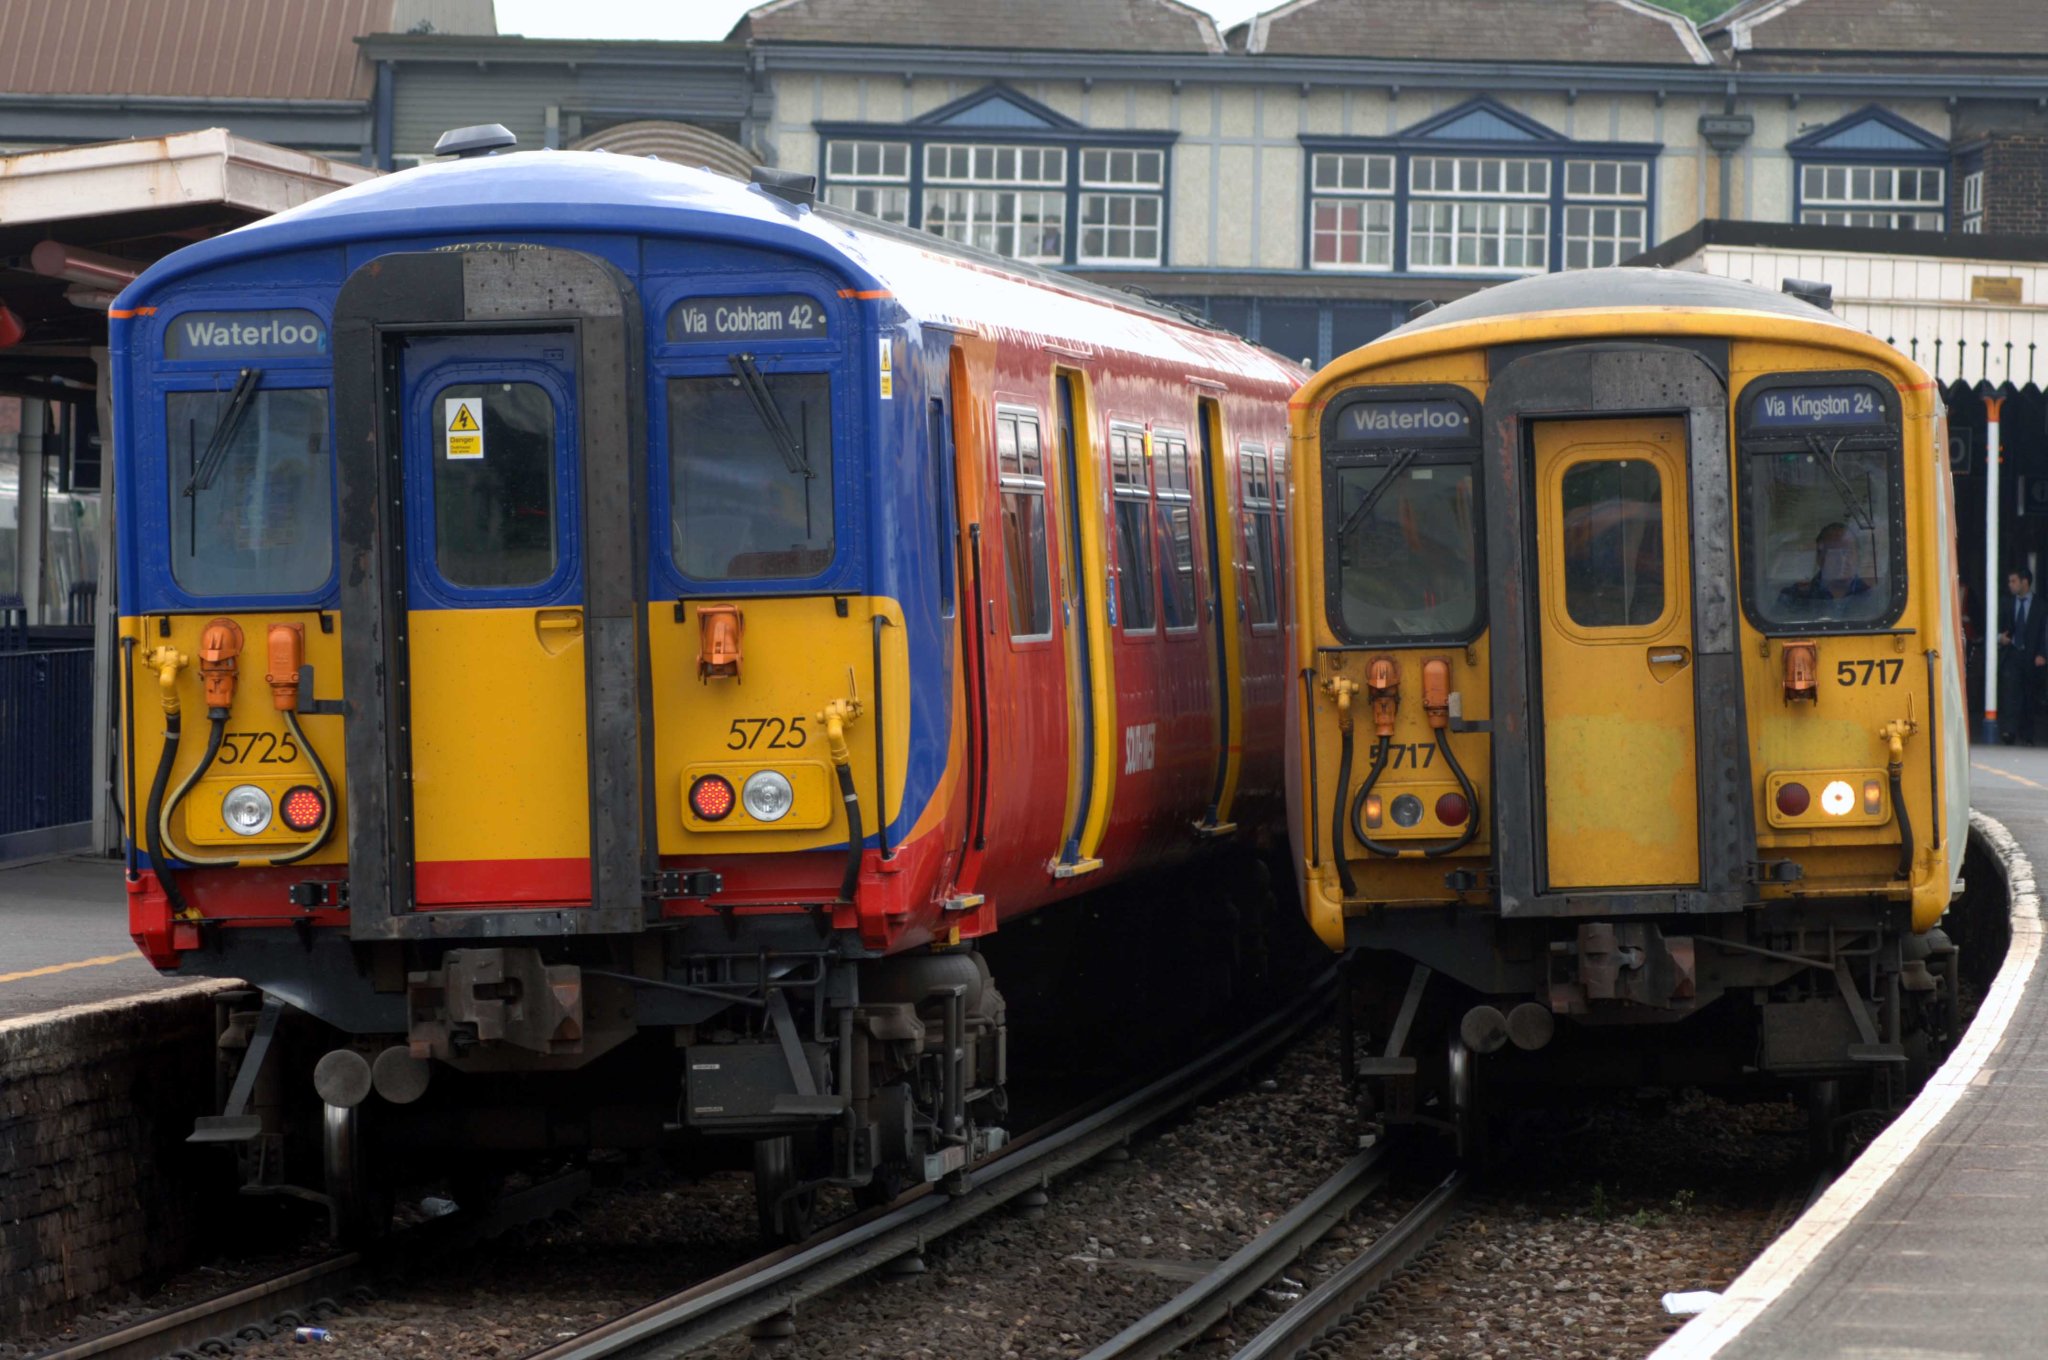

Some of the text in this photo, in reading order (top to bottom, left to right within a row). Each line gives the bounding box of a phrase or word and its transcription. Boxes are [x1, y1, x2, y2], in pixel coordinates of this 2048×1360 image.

[682, 304, 813, 333] Via Cobham 42
[186, 320, 318, 347] Waterloo
[1353, 408, 1460, 431] Waterloo
[1765, 392, 1873, 421] Via Kingston 24
[1837, 658, 1904, 687] 5717
[218, 732, 299, 765] 5725
[727, 717, 807, 751] 5725
[1369, 743, 1435, 769] 5717
